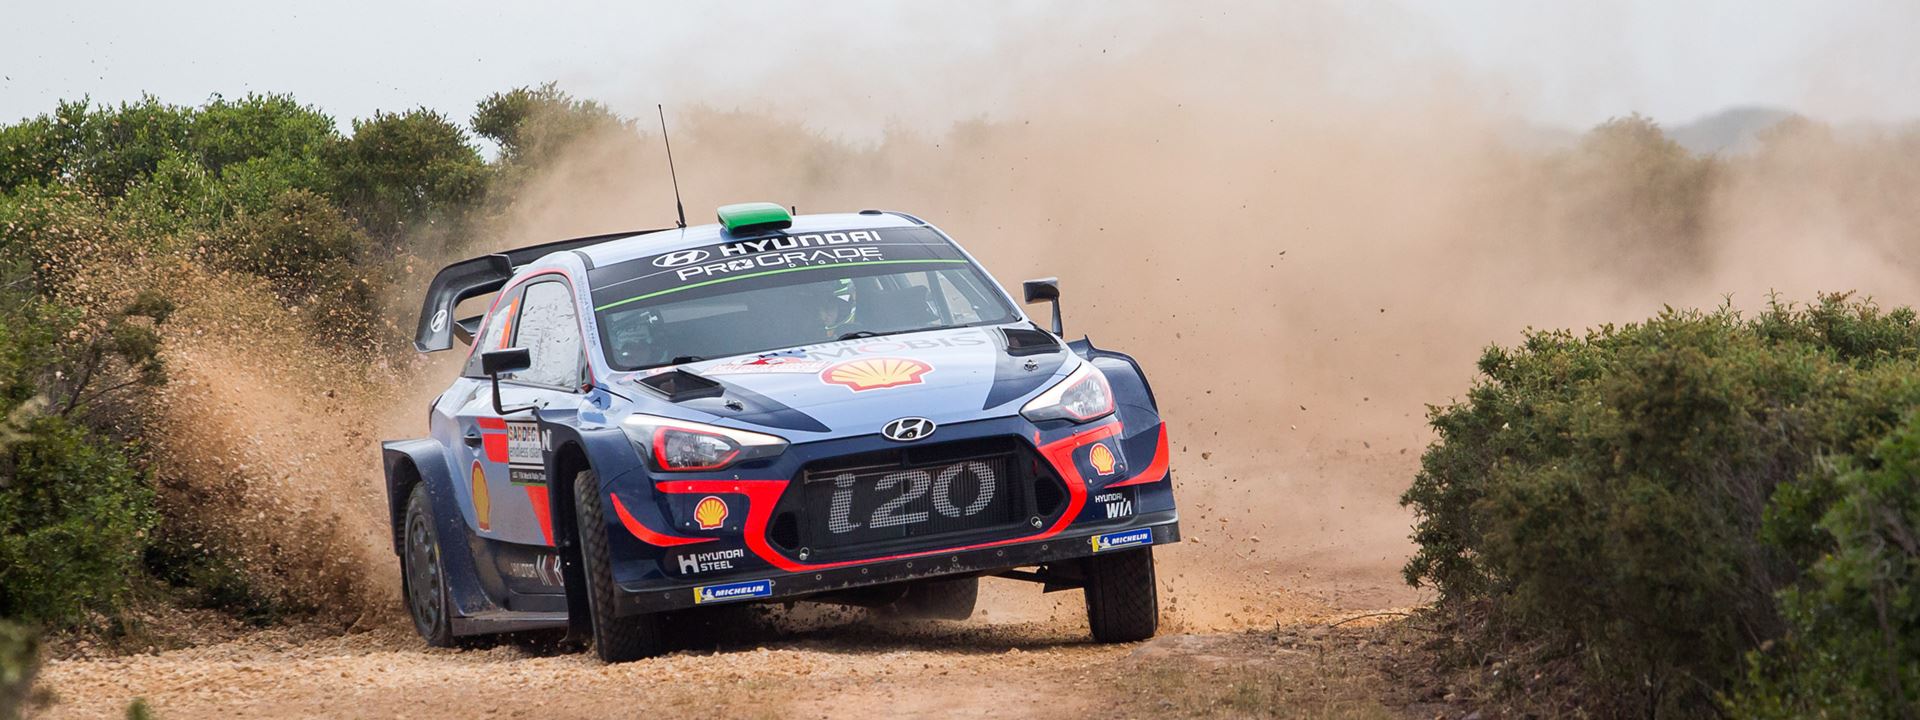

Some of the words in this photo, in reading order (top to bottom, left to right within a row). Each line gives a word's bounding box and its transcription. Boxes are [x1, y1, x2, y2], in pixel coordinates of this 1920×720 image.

[718, 230, 882, 257] HYUNDAI
[788, 256, 885, 268] DIGITAL
[808, 335, 986, 361] MOBIS
[828, 461, 996, 534] i20
[1094, 492, 1123, 503] HYUNDAI
[1106, 497, 1133, 519] WIA
[1111, 533, 1148, 545] MICHELIN
[698, 548, 744, 562] HYUNDAI
[700, 560, 734, 572] STEEL
[715, 585, 765, 597] MICHELIN
